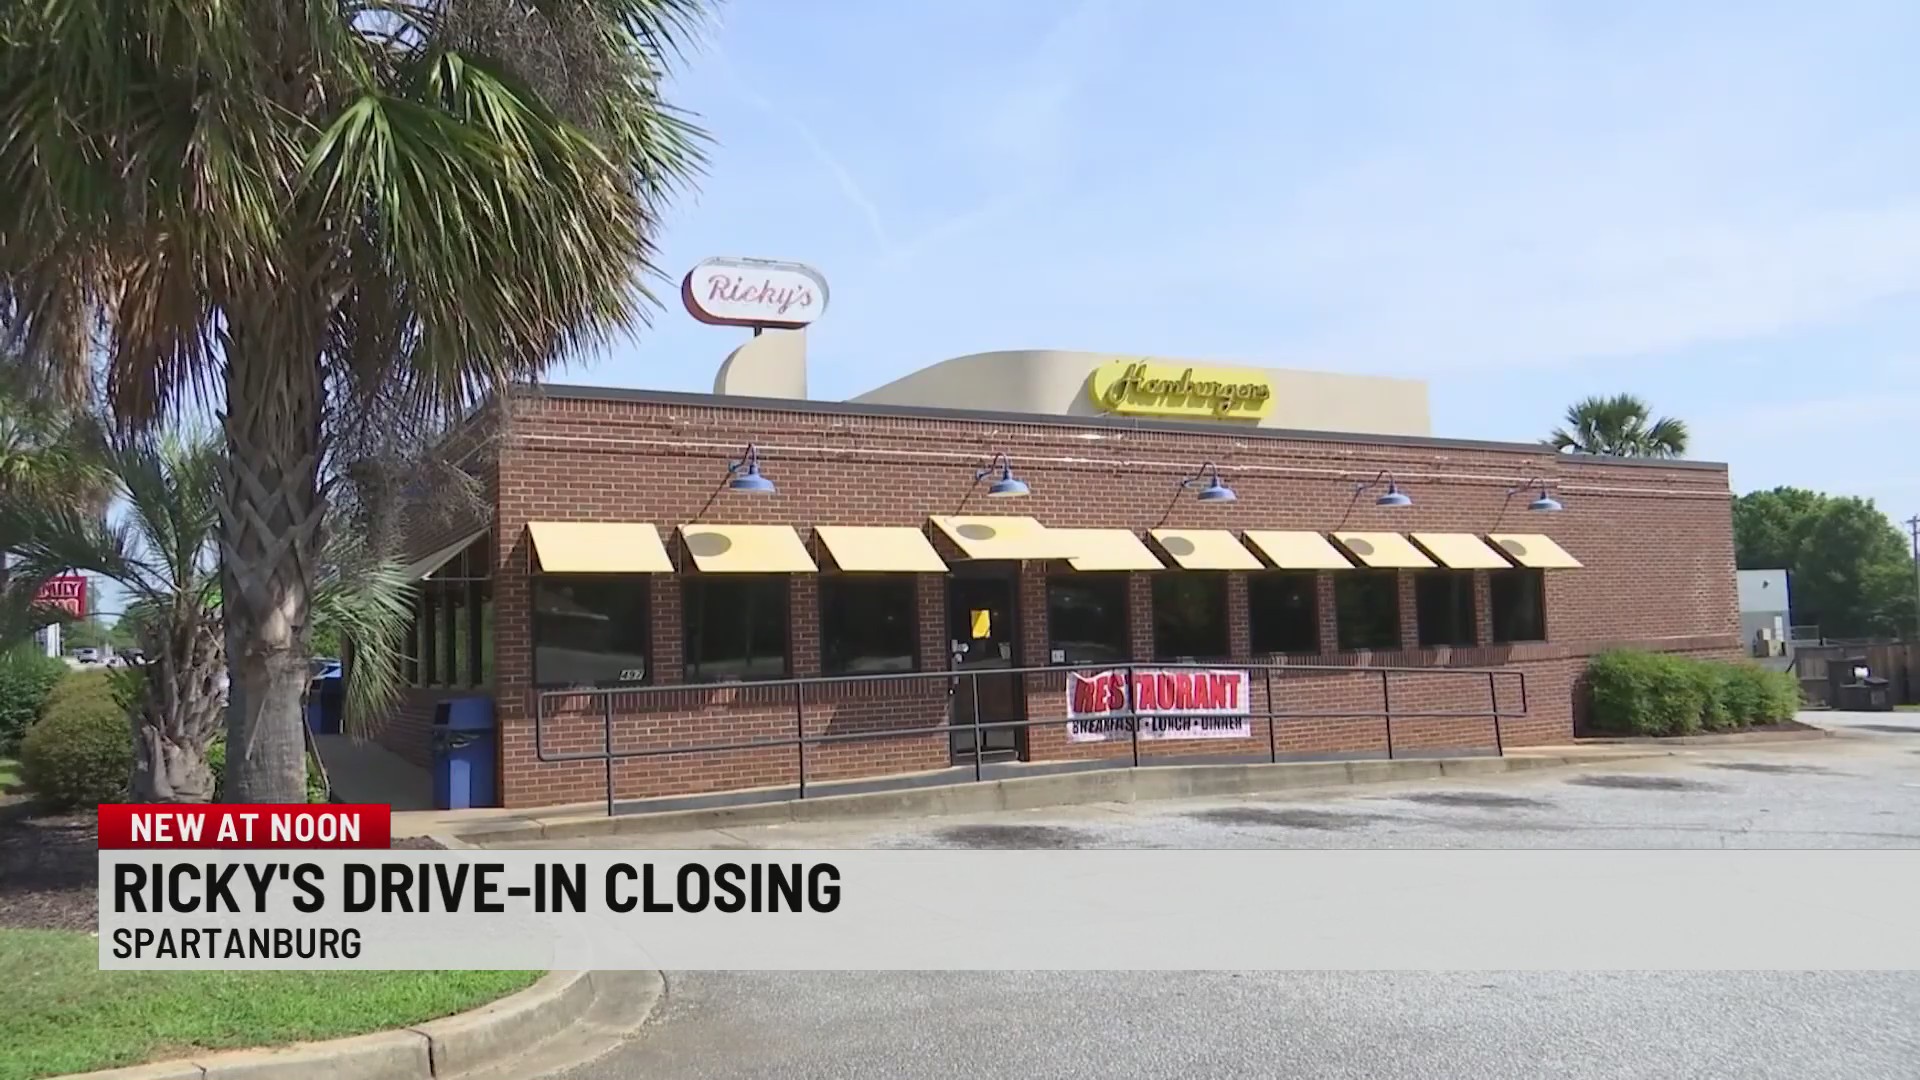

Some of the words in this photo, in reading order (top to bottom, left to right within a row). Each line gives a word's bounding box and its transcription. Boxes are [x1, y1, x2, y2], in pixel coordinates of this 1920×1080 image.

[707, 274, 813, 315] Ricky's
[1106, 362, 1270, 416] Hamburgers
[1152, 716, 1191, 732] LUNCH
[1201, 715, 1242, 730] DINNER
